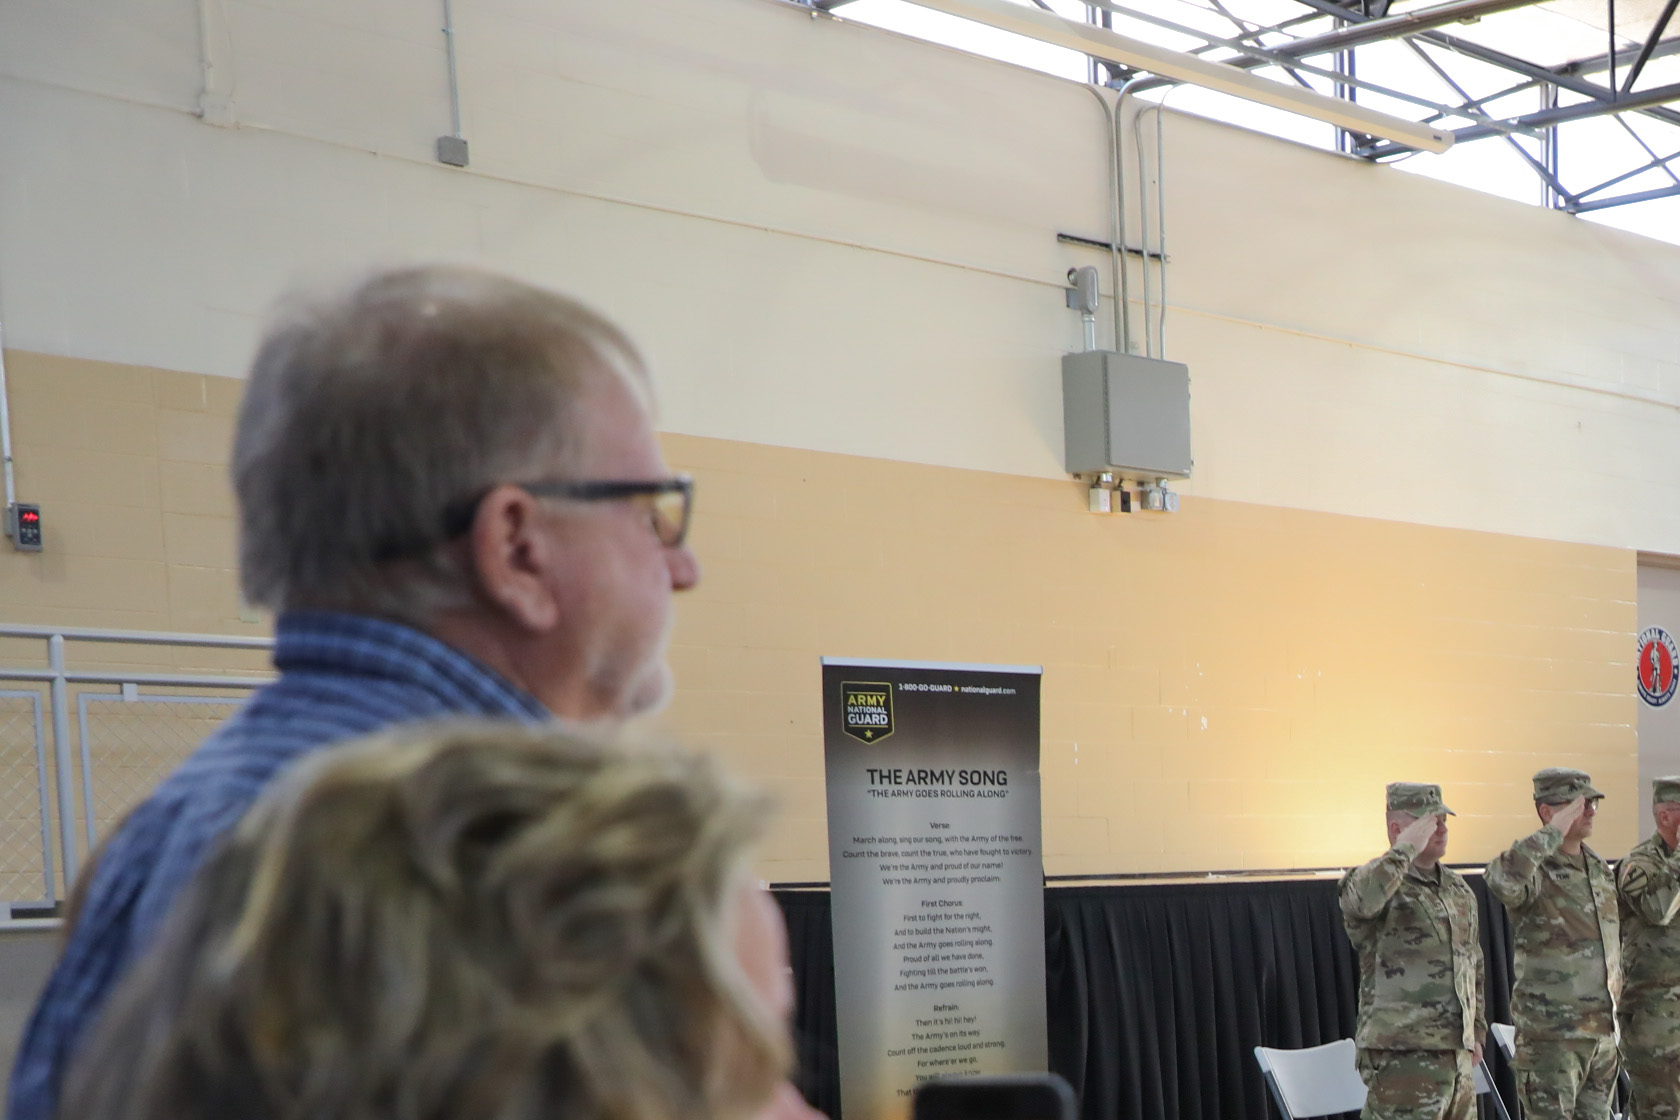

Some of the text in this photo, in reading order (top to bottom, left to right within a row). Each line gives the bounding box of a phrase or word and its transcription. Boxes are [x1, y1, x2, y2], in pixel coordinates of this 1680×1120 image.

[960, 686, 1017, 696] nationalguard.com
[847, 695, 886, 706] ARMY
[847, 706, 888, 714] NATIONAL
[847, 714, 889, 725] GUARD
[866, 769, 1008, 786] THE ARMY SONG
[915, 790, 939, 798] GOES
[940, 790, 975, 798] ROLLING
[971, 835, 989, 844] Army
[911, 864, 929, 872] Army
[944, 863, 962, 871] proud
[947, 876, 969, 884] proudly
[927, 914, 943, 922] fight
[918, 942, 937, 950] Army
[899, 969, 926, 978] Fighting
[956, 980, 976, 988] rolling
[916, 1019, 933, 1027] Then
[907, 1047, 916, 1055] off
[929, 1044, 956, 1053] cadence
